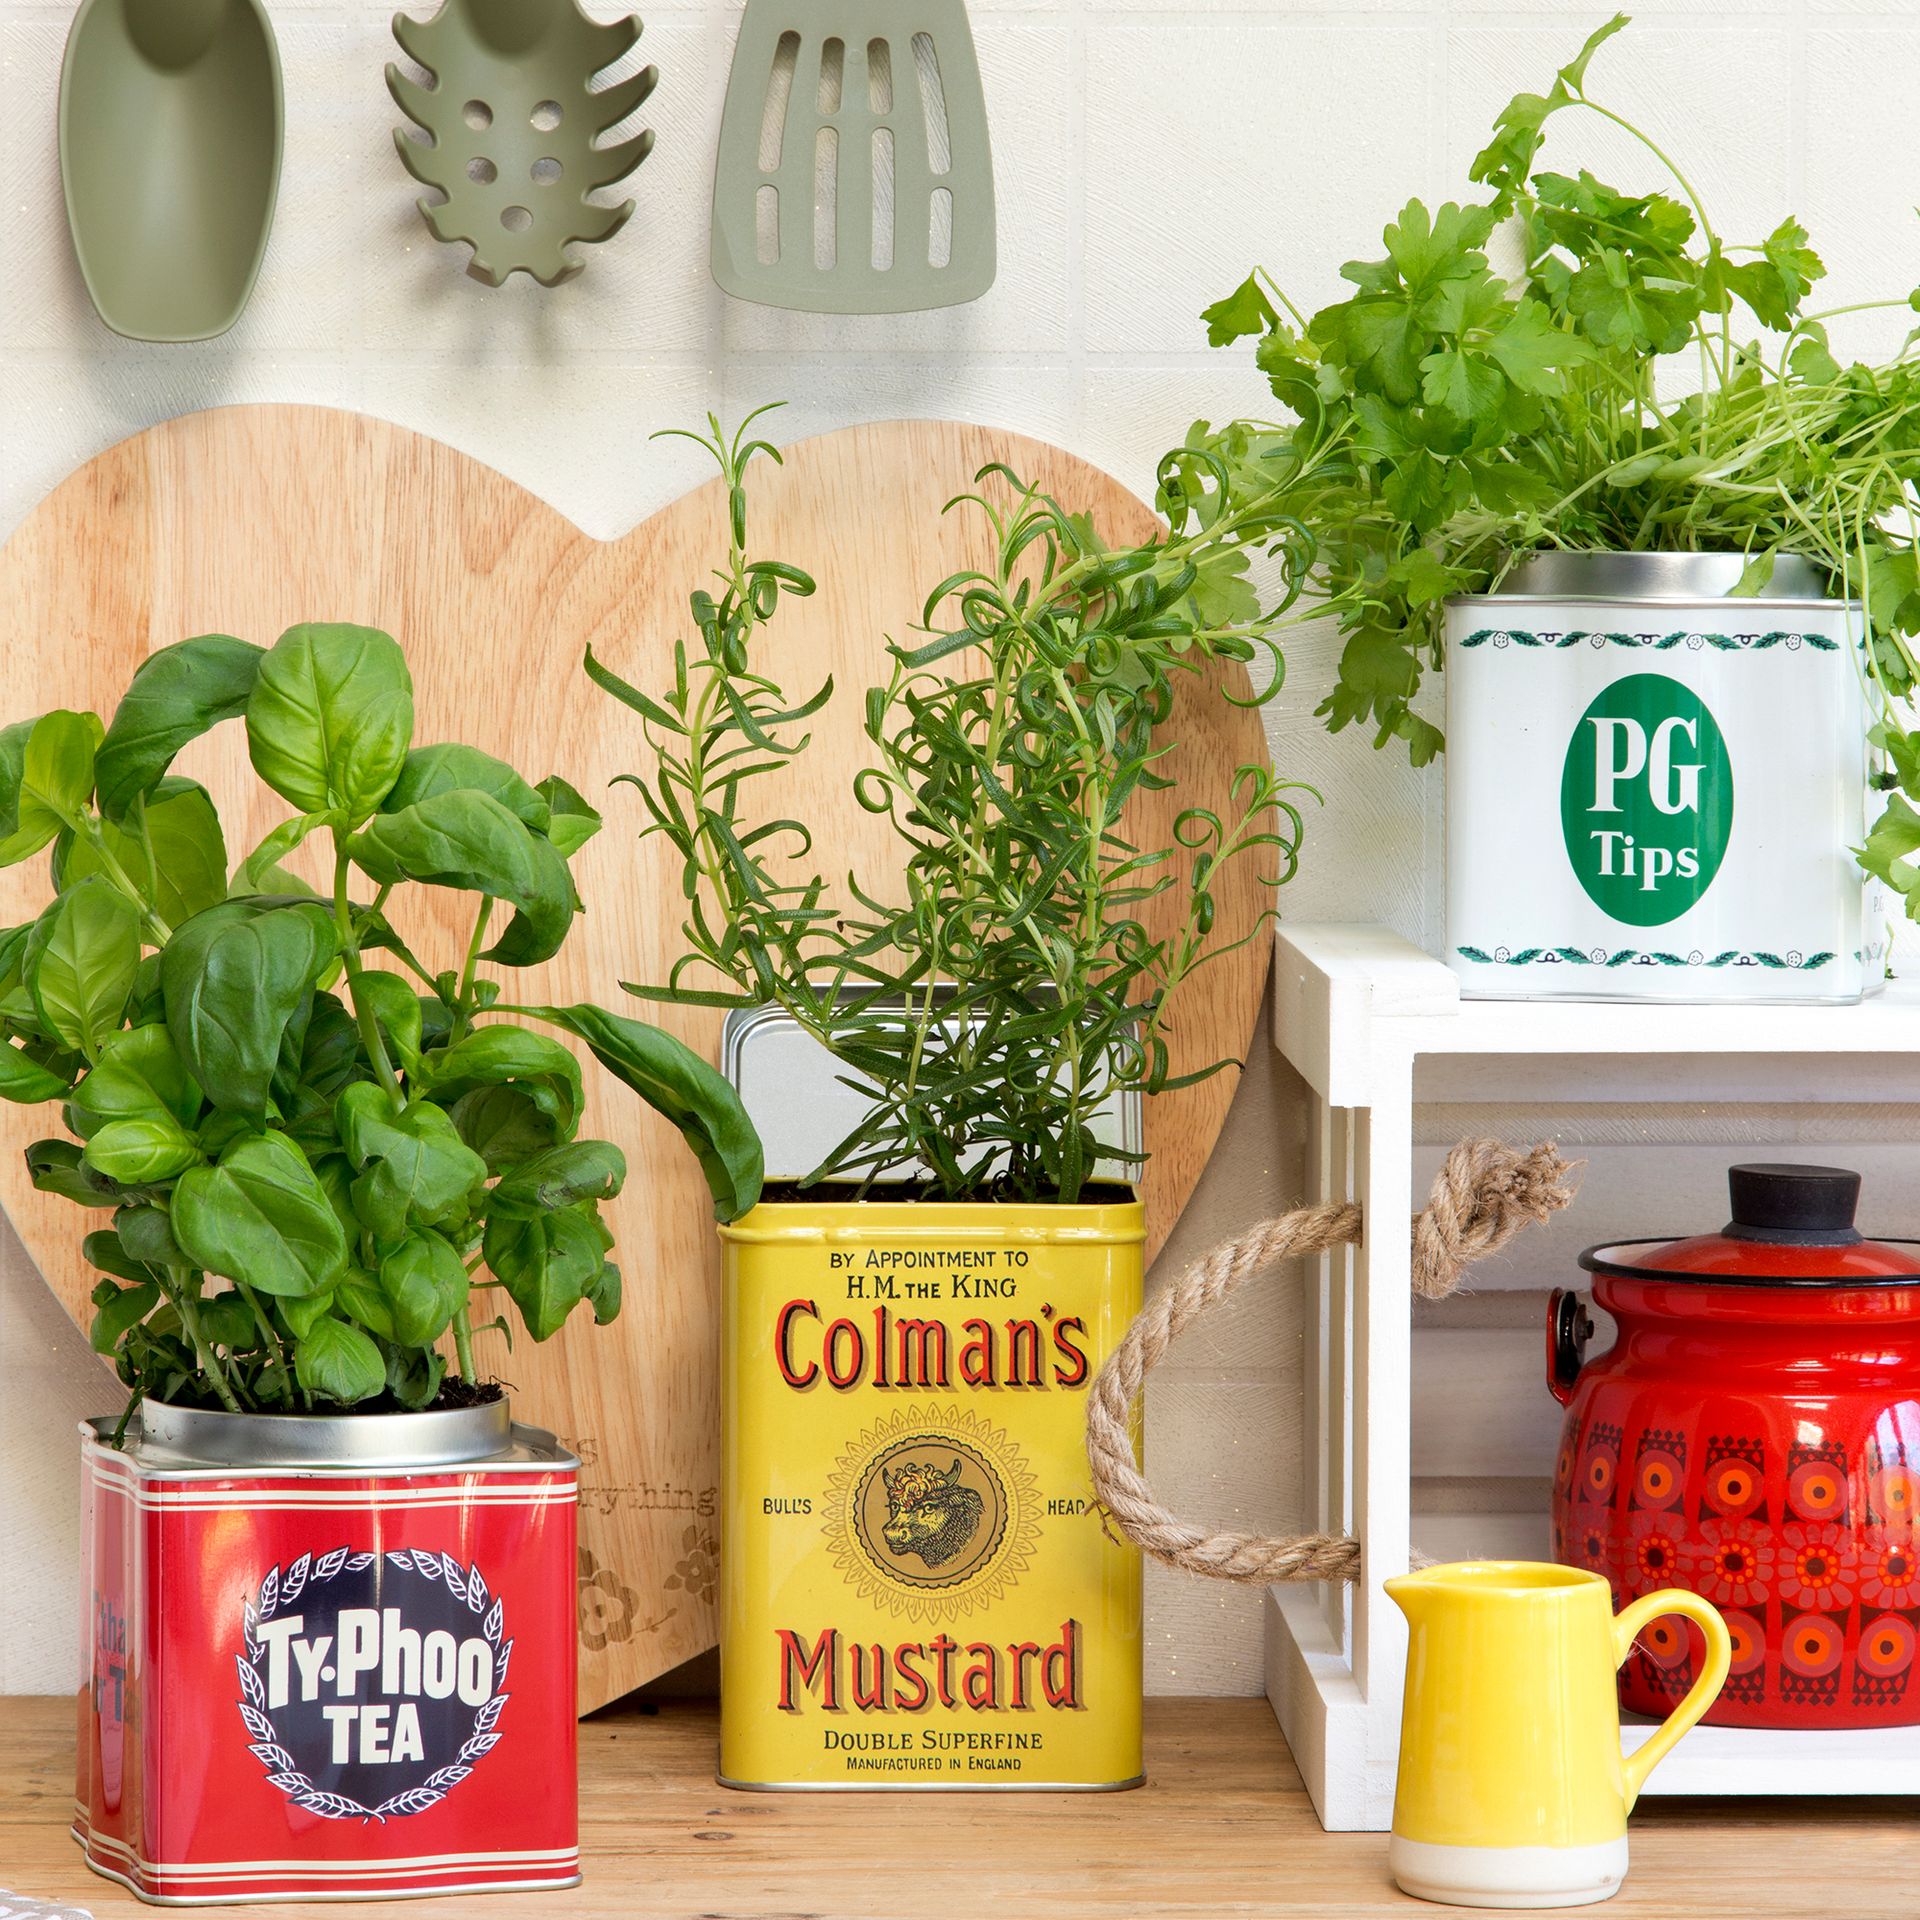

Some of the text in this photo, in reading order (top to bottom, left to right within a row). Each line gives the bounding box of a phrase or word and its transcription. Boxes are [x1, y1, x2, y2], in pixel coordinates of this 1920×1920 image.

[1586, 716, 1707, 815] PG
[1590, 831, 1700, 891] Tips
[830, 1249, 1029, 1269] BY APPOINTMENT TO
[904, 1282, 941, 1299] THE
[951, 1274, 1018, 1299] KING
[775, 1299, 1092, 1393] Colman's
[762, 1497, 812, 1515] BULL'S
[775, 1618, 1087, 1715] Mustard
[322, 1703, 425, 1765] TEA
[823, 1729, 1044, 1751] DOUBLE SUPERFINE
[846, 1756, 1022, 1771] MANUFACTURED IN ENGLAND
